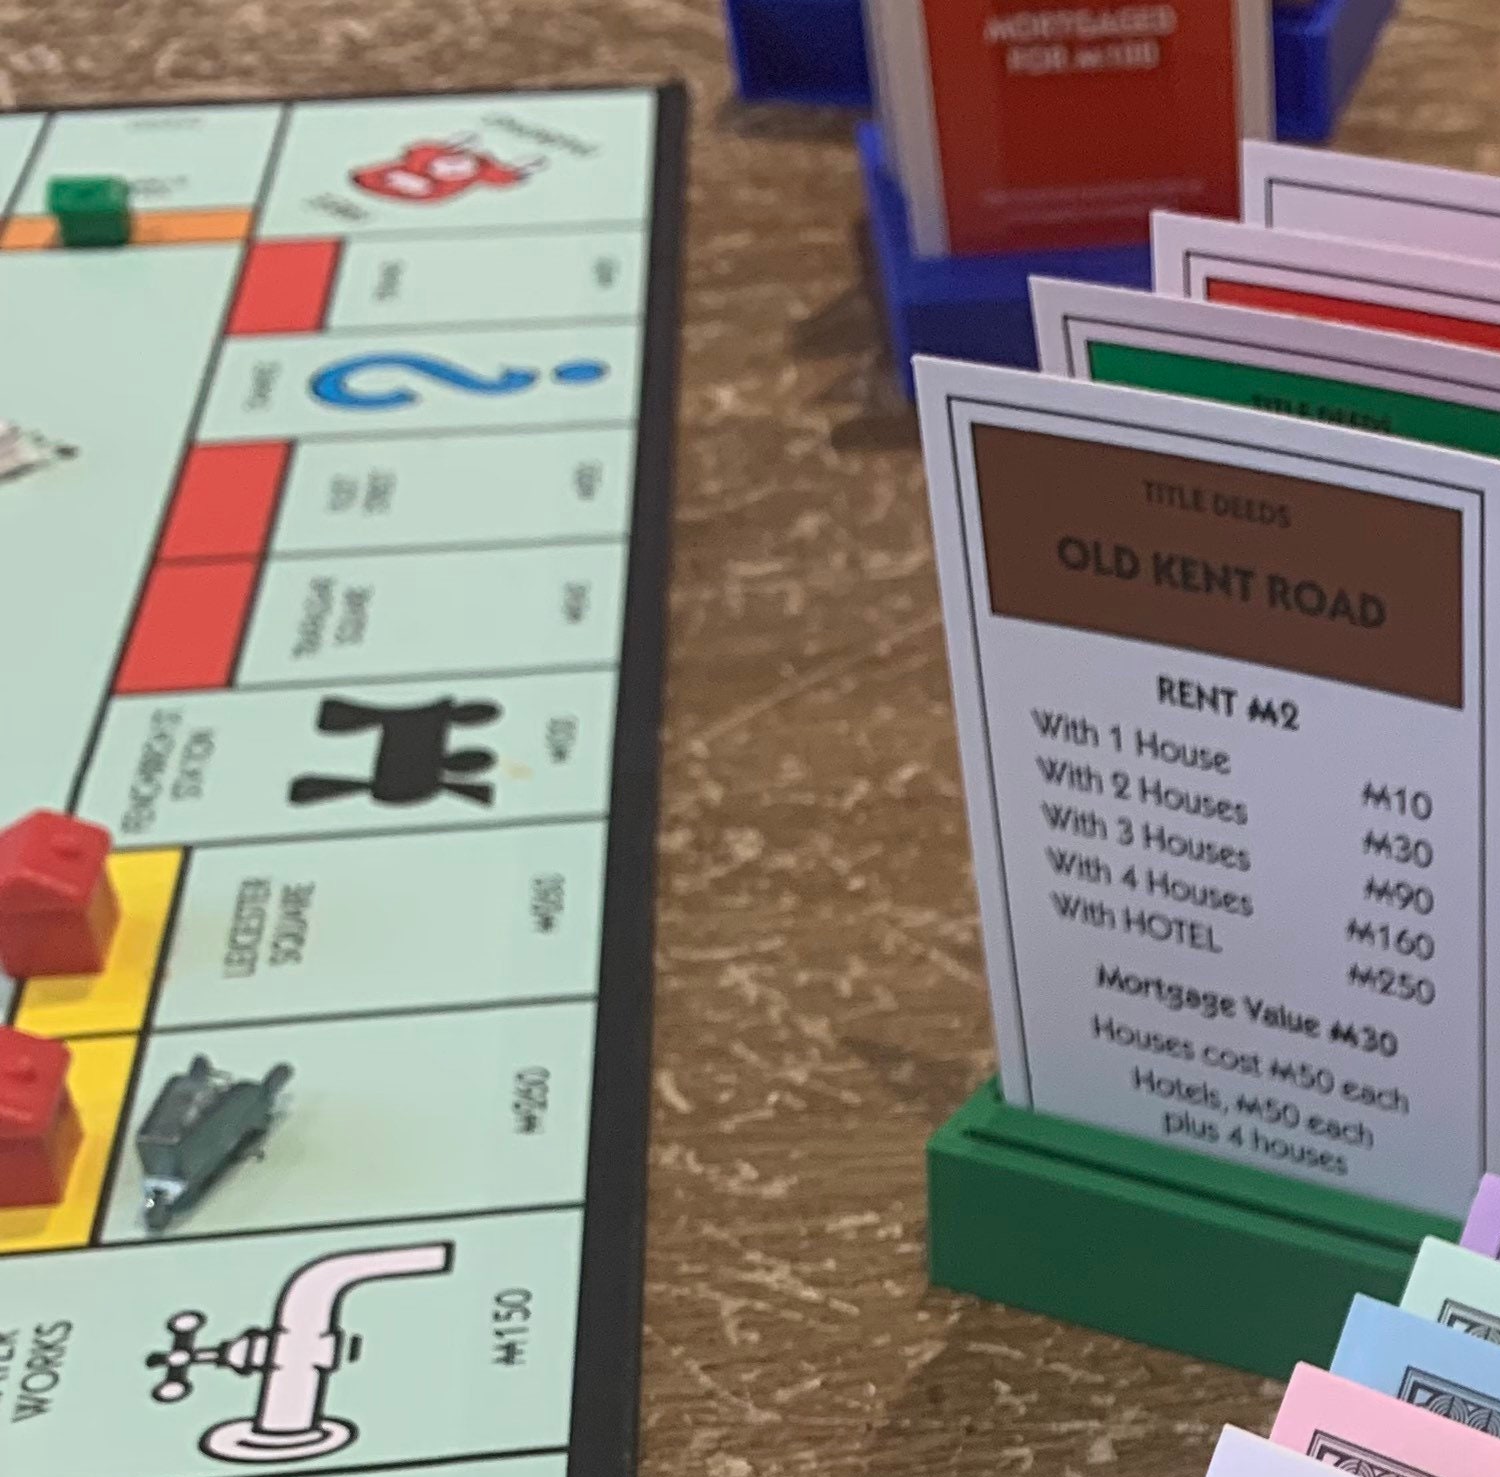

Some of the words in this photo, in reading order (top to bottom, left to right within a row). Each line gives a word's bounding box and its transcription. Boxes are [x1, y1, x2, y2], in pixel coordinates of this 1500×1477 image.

[1143, 480, 1206, 512] TITLE
[1213, 492, 1292, 528] DEEDS
[1057, 535, 1140, 580] OLD
[1151, 550, 1255, 602] KENT
[1266, 573, 1387, 629] ROAD
[1157, 674, 1238, 717] RENT
[1030, 706, 1100, 748] With
[1109, 724, 1122, 752] 1
[1135, 727, 1231, 774] House
[1035, 755, 1104, 795] With
[1111, 769, 1131, 800] 2
[1138, 776, 1248, 826] Houses
[1041, 801, 1108, 840] With
[1116, 815, 1135, 846] 3
[1142, 820, 1250, 872] Houses
[1044, 845, 1112, 885] With
[1120, 864, 1138, 892] 4
[1146, 868, 1254, 917] Houses
[1050, 890, 1116, 930] With
[1122, 905, 1223, 953] HOTEL
[1096, 962, 1237, 1018] Mortgage
[1243, 995, 1320, 1038] Value
[1092, 1013, 1195, 1060] Houses
[1202, 1046, 1263, 1078] cost
[1341, 1079, 1410, 1116] each
[1132, 1065, 1229, 1116] Hotels,
[1306, 1113, 1374, 1150] each
[1164, 1110, 1219, 1143] plus
[1228, 1126, 1242, 1148] 4
[1254, 1127, 1348, 1176] houses
[10, 1320, 73, 1423] WORKS
